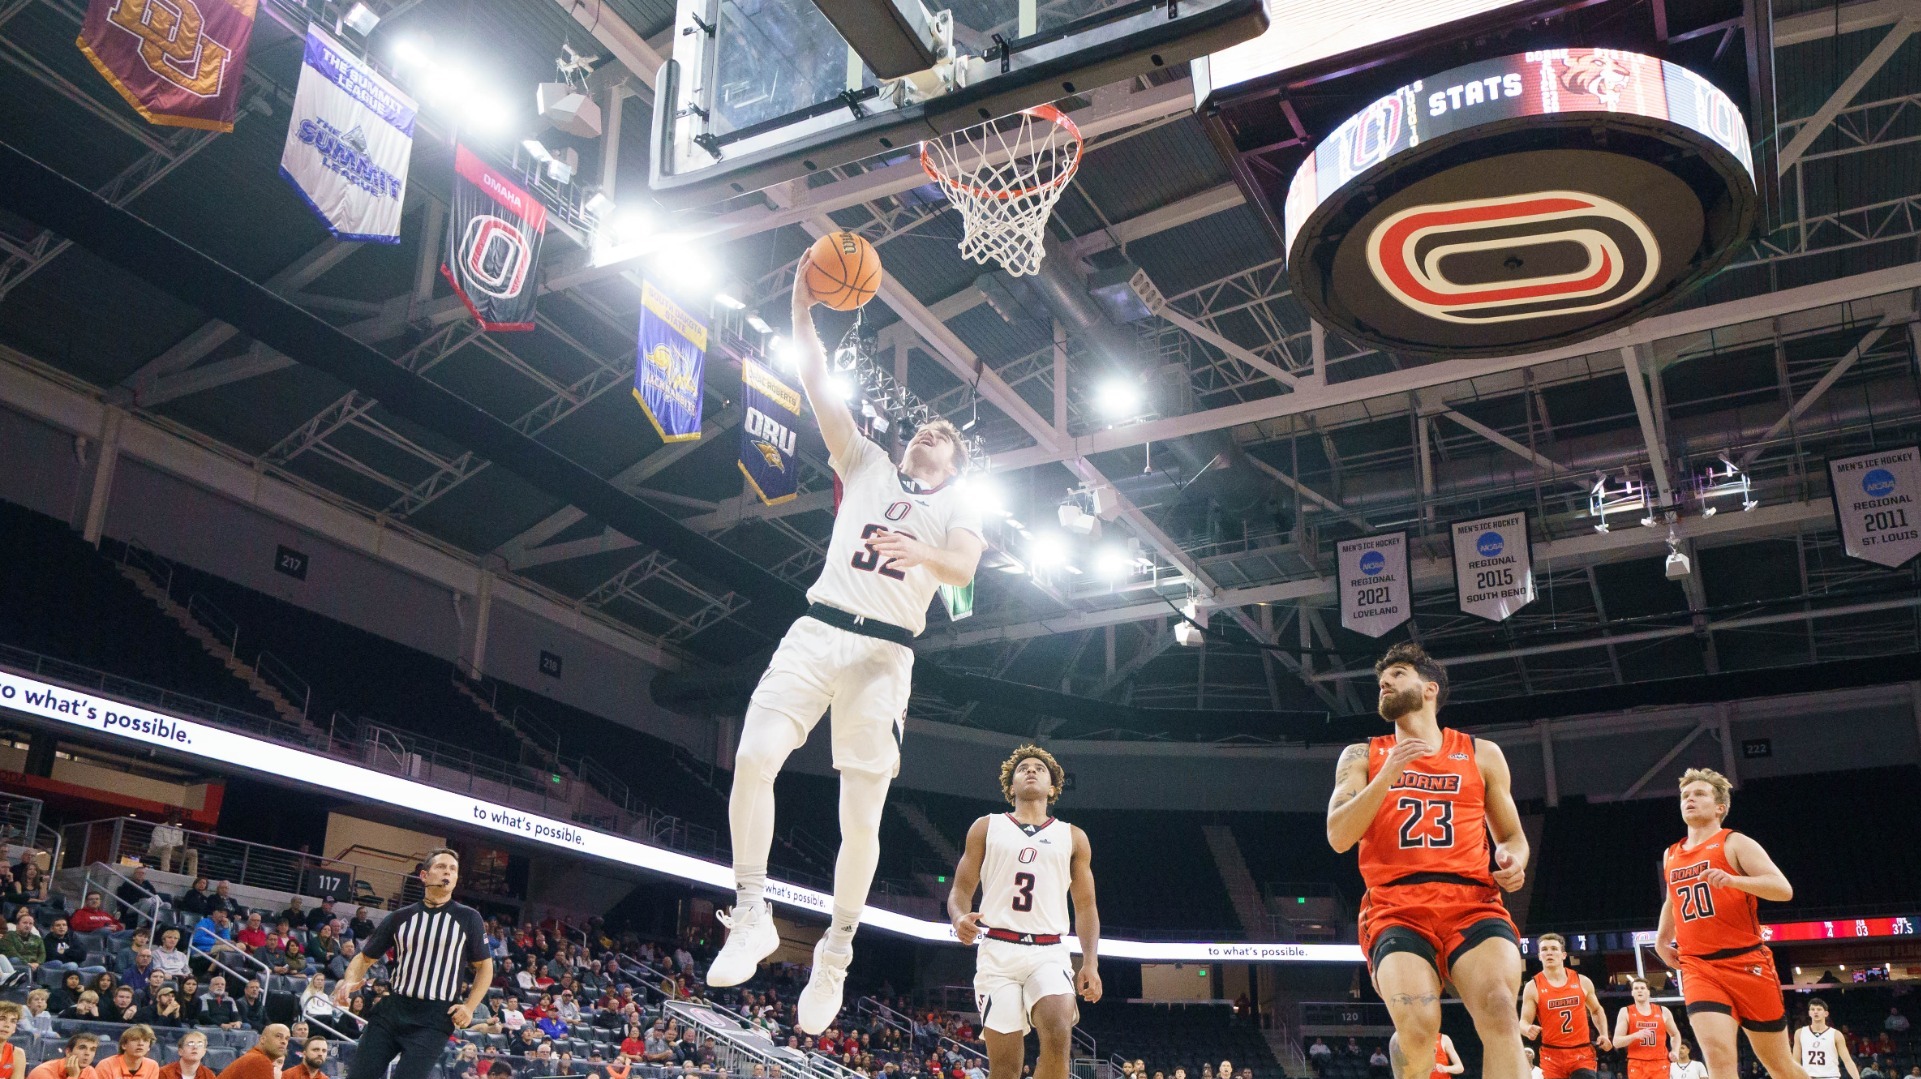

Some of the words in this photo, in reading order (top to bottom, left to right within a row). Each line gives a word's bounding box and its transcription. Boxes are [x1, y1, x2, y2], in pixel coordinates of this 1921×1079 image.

[323, 47, 348, 74] THE
[350, 68, 404, 114] SUMMIT
[337, 73, 387, 115] LEAGUE
[1429, 73, 1523, 117] STATS
[316, 116, 342, 137] THE
[296, 118, 402, 201] SUMMIT
[321, 156, 379, 198] LEAGUE
[483, 173, 522, 209] OMAHA
[744, 406, 797, 458] ORU
[1837, 462, 1863, 472] MEN'S
[1865, 458, 1879, 467] ICE
[1881, 453, 1913, 464] HOCKEY
[1853, 495, 1913, 511] REGIONAL
[1458, 525, 1479, 534] MEN'S
[1480, 522, 1491, 530] ICE
[1493, 518, 1519, 528] HOCKEY
[1864, 509, 1908, 532] 2011
[1342, 543, 1362, 552] MEN'S
[1363, 541, 1374, 549] ICE
[1375, 538, 1400, 548] HOCKEY
[1862, 537, 1880, 546] ST.
[1882, 530, 1918, 544] LOUIS
[280, 554, 302, 571] 217
[1468, 555, 1517, 569] REGIONAL
[1351, 575, 1396, 587] REGIONAL
[1477, 568, 1513, 589] 2015
[1357, 587, 1391, 606] 2021
[1467, 591, 1498, 603] SOUTH
[1501, 587, 1526, 598] BEND
[1353, 606, 1398, 619] LOVELAND
[0, 683, 16, 699] o
[24, 689, 97, 720] what's
[103, 709, 192, 744] possible.
[1394, 772, 1459, 791] DOANE
[473, 805, 487, 820] to
[491, 810, 531, 831] what's
[534, 824, 585, 846] possible.
[1397, 796, 1455, 849] 23
[1671, 862, 1709, 881] DOANE
[319, 875, 341, 891] 117
[1012, 872, 1036, 912] 3
[765, 886, 791, 899] what's
[793, 889, 826, 908] possible.
[1677, 881, 1715, 923] 20
[1892, 923, 1914, 935] 37.5
[1208, 947, 1219, 956] to
[1223, 946, 1258, 956] what's
[1261, 946, 1308, 958] possible.
[1341, 1012, 1359, 1021] 120
[1560, 1010, 1573, 1034] 2
[1808, 1051, 1826, 1066] 23
